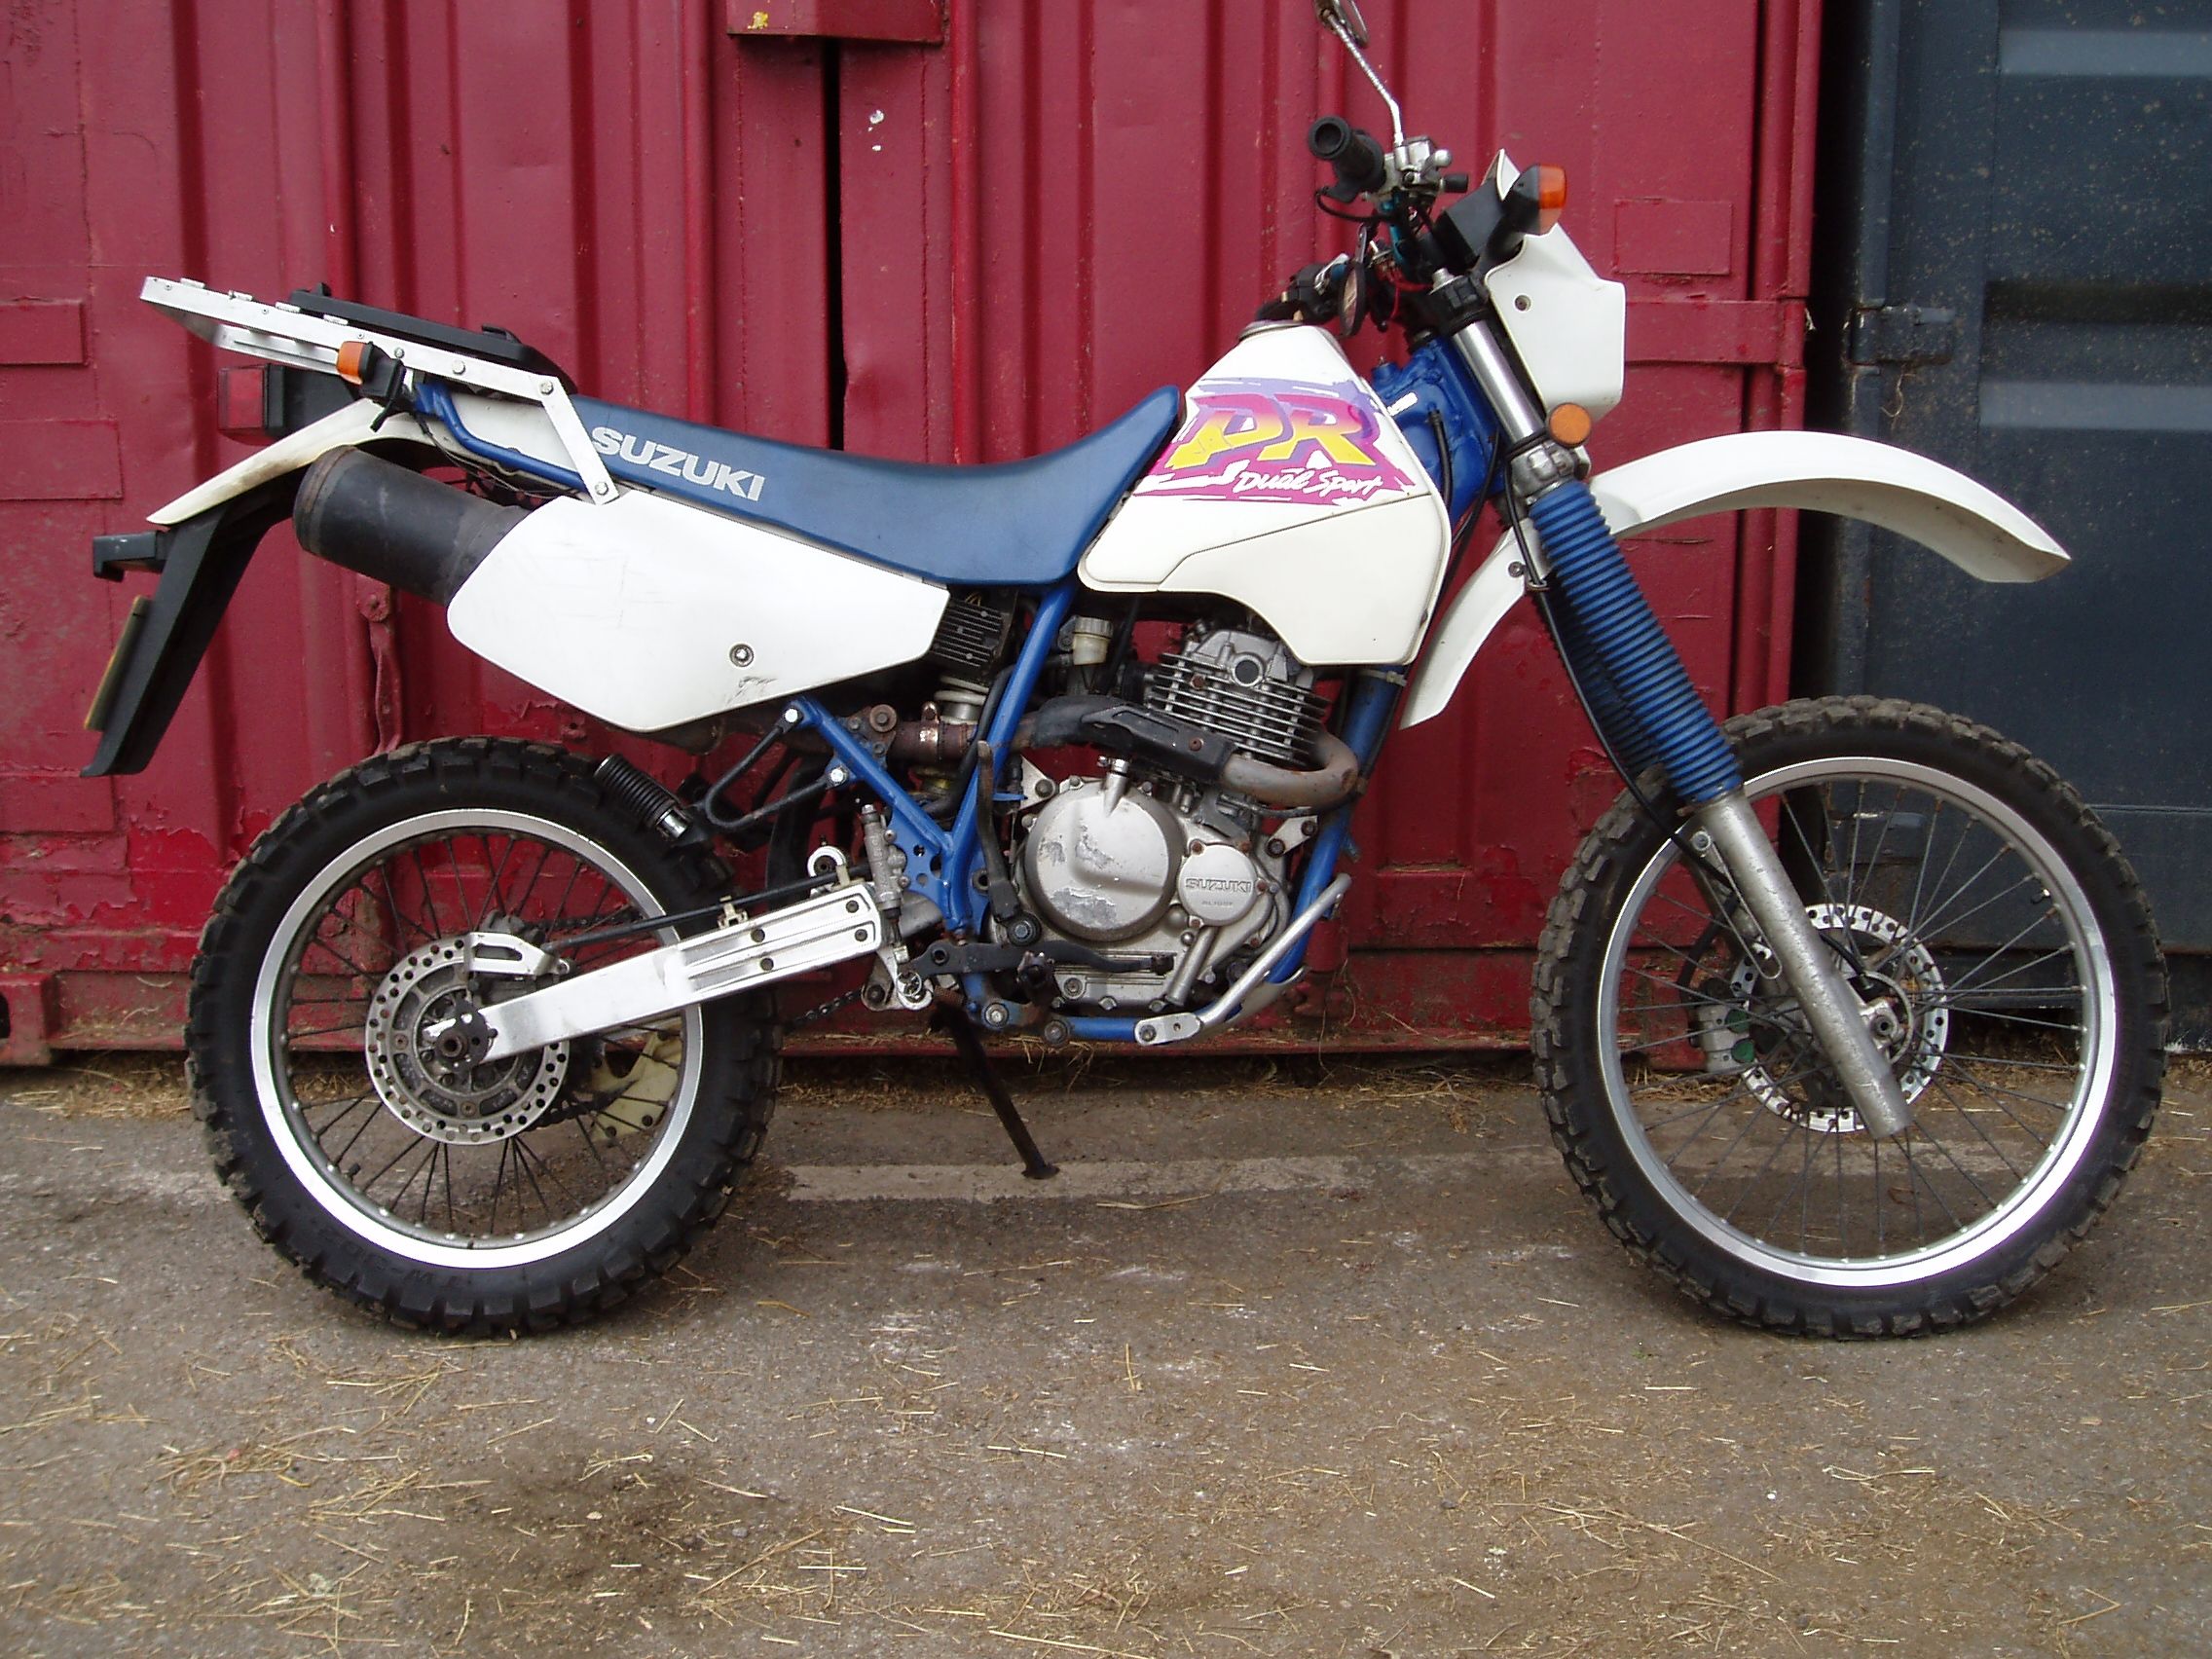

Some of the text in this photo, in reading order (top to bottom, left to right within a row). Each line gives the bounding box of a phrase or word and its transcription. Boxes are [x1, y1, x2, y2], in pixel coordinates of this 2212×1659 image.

[1164, 392, 1377, 469] DR
[592, 426, 766, 501] SUZUKI
[1233, 468, 1383, 498] Dual Sport
[1185, 877, 1253, 893] SUZUKI
